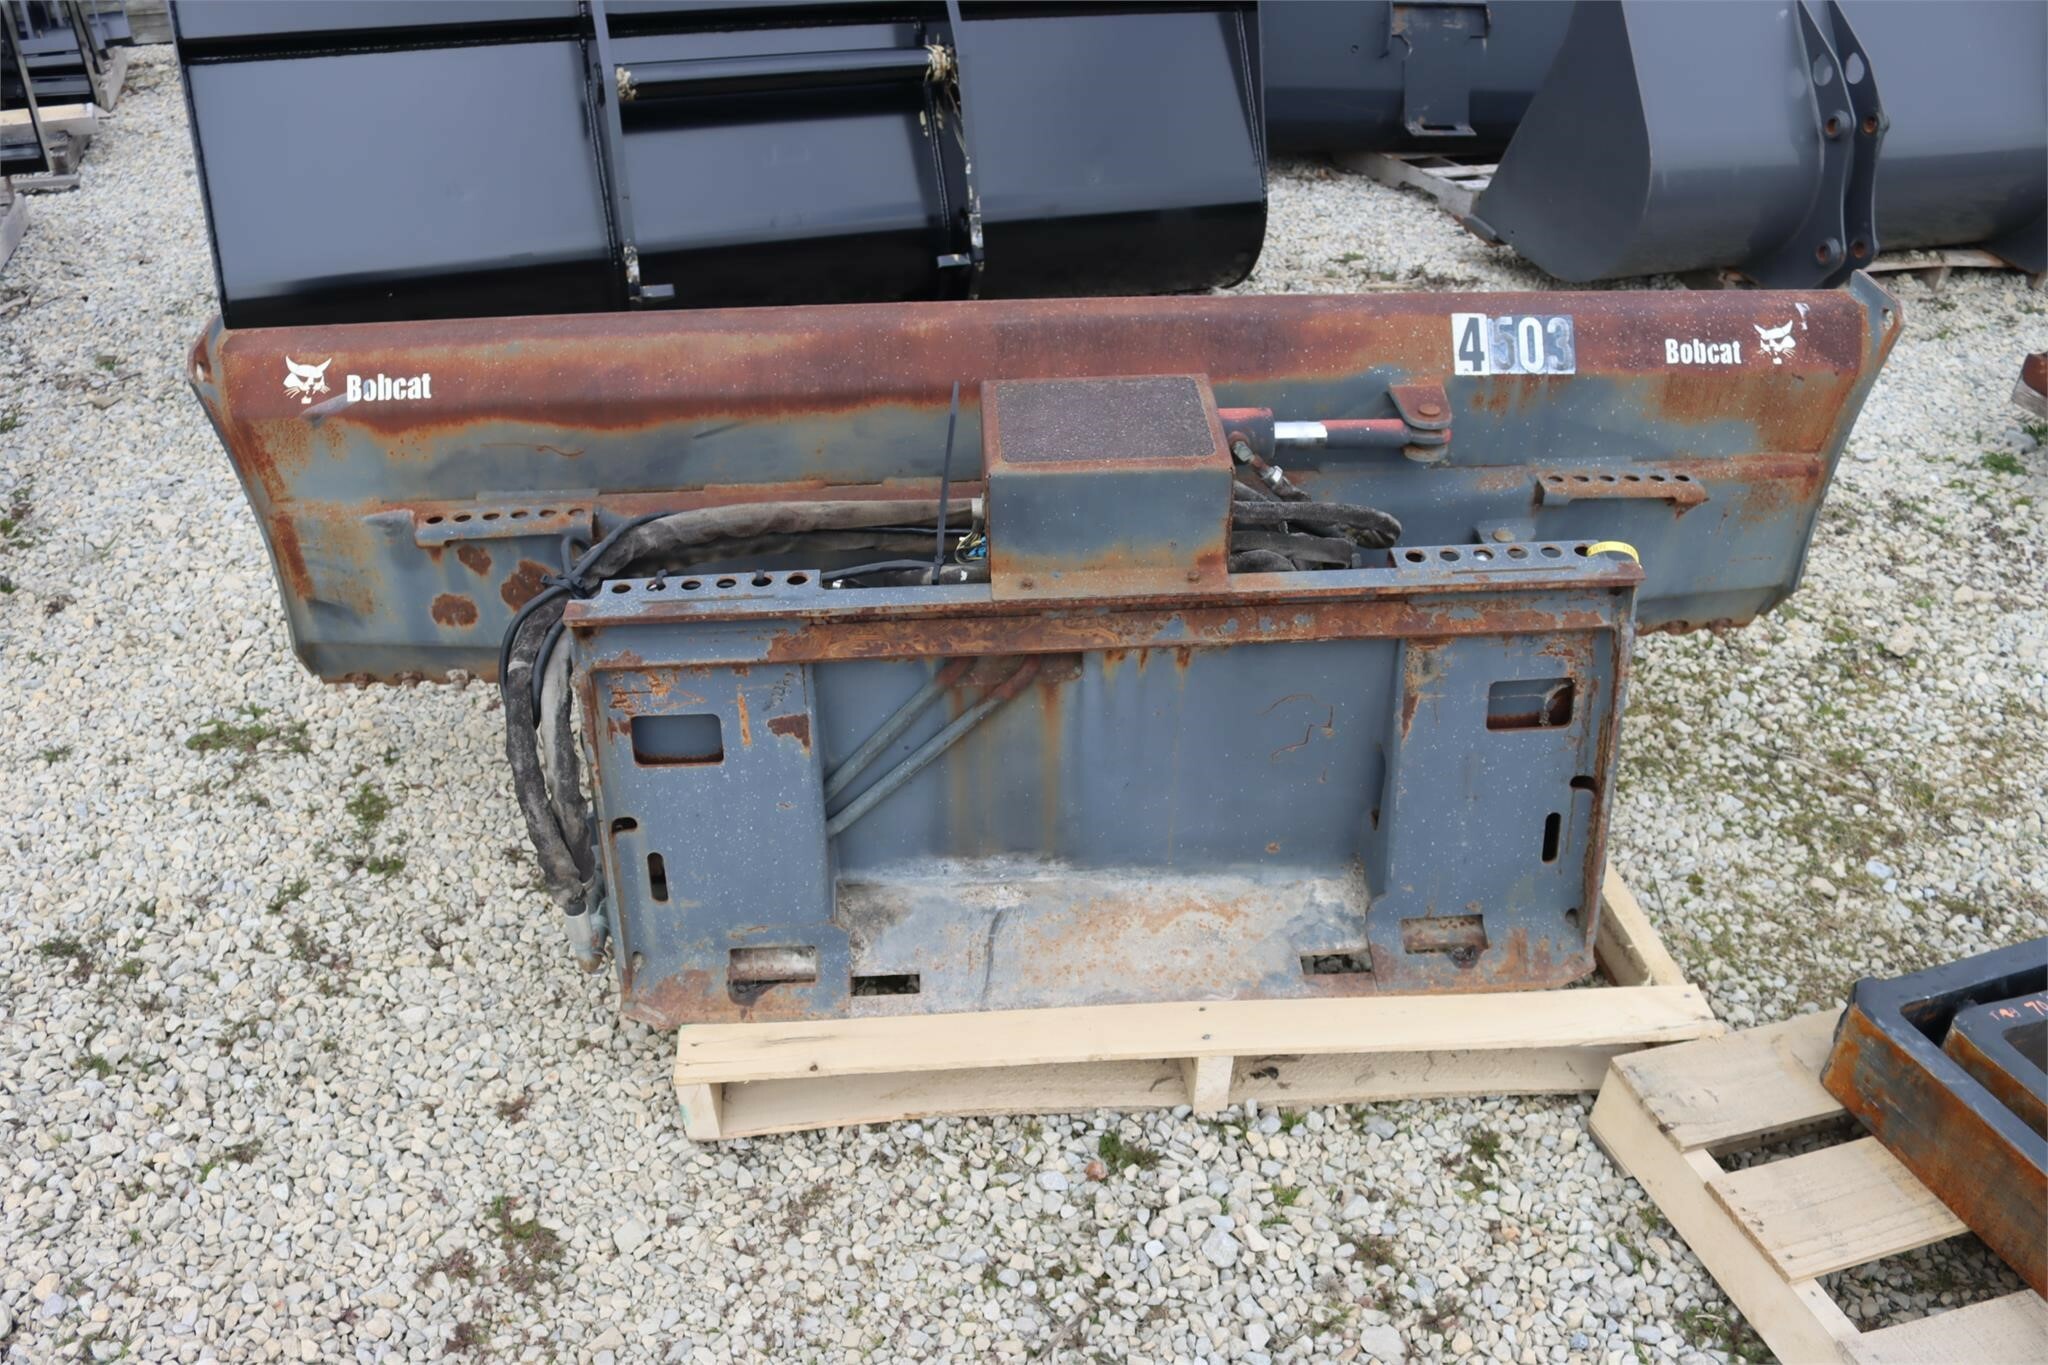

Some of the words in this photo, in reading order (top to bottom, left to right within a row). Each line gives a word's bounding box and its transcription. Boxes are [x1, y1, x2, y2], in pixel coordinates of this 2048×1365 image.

[1458, 316, 1571, 373] 4503
[1665, 338, 1742, 364] Bobcat
[346, 373, 432, 402] Bobcat
